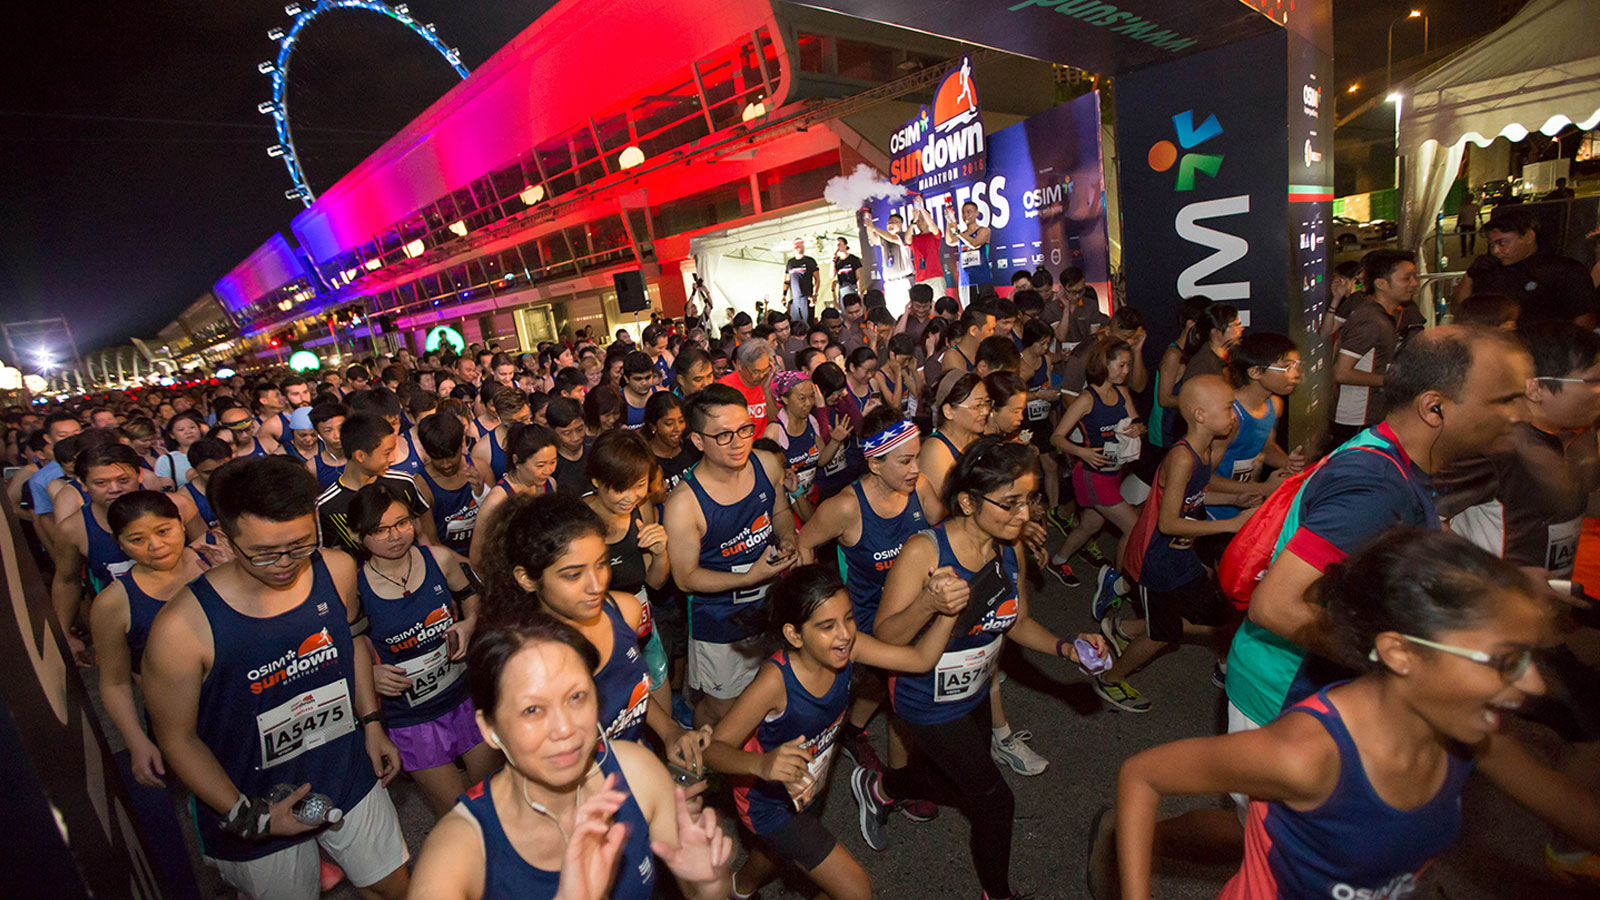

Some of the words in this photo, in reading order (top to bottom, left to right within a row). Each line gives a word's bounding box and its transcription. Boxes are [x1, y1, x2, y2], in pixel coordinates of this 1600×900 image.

[890, 121, 921, 154] OSIM
[890, 121, 984, 185] sundown
[918, 167, 959, 191] MARATHON
[962, 158, 984, 177] 2016
[1022, 183, 1062, 210] OSIM
[873, 547, 900, 561] OSIM
[385, 627, 416, 645] OSIM
[247, 656, 287, 681] OSIM
[250, 647, 338, 695] sundown
[415, 660, 453, 691] A547
[276, 705, 345, 749] A5475
